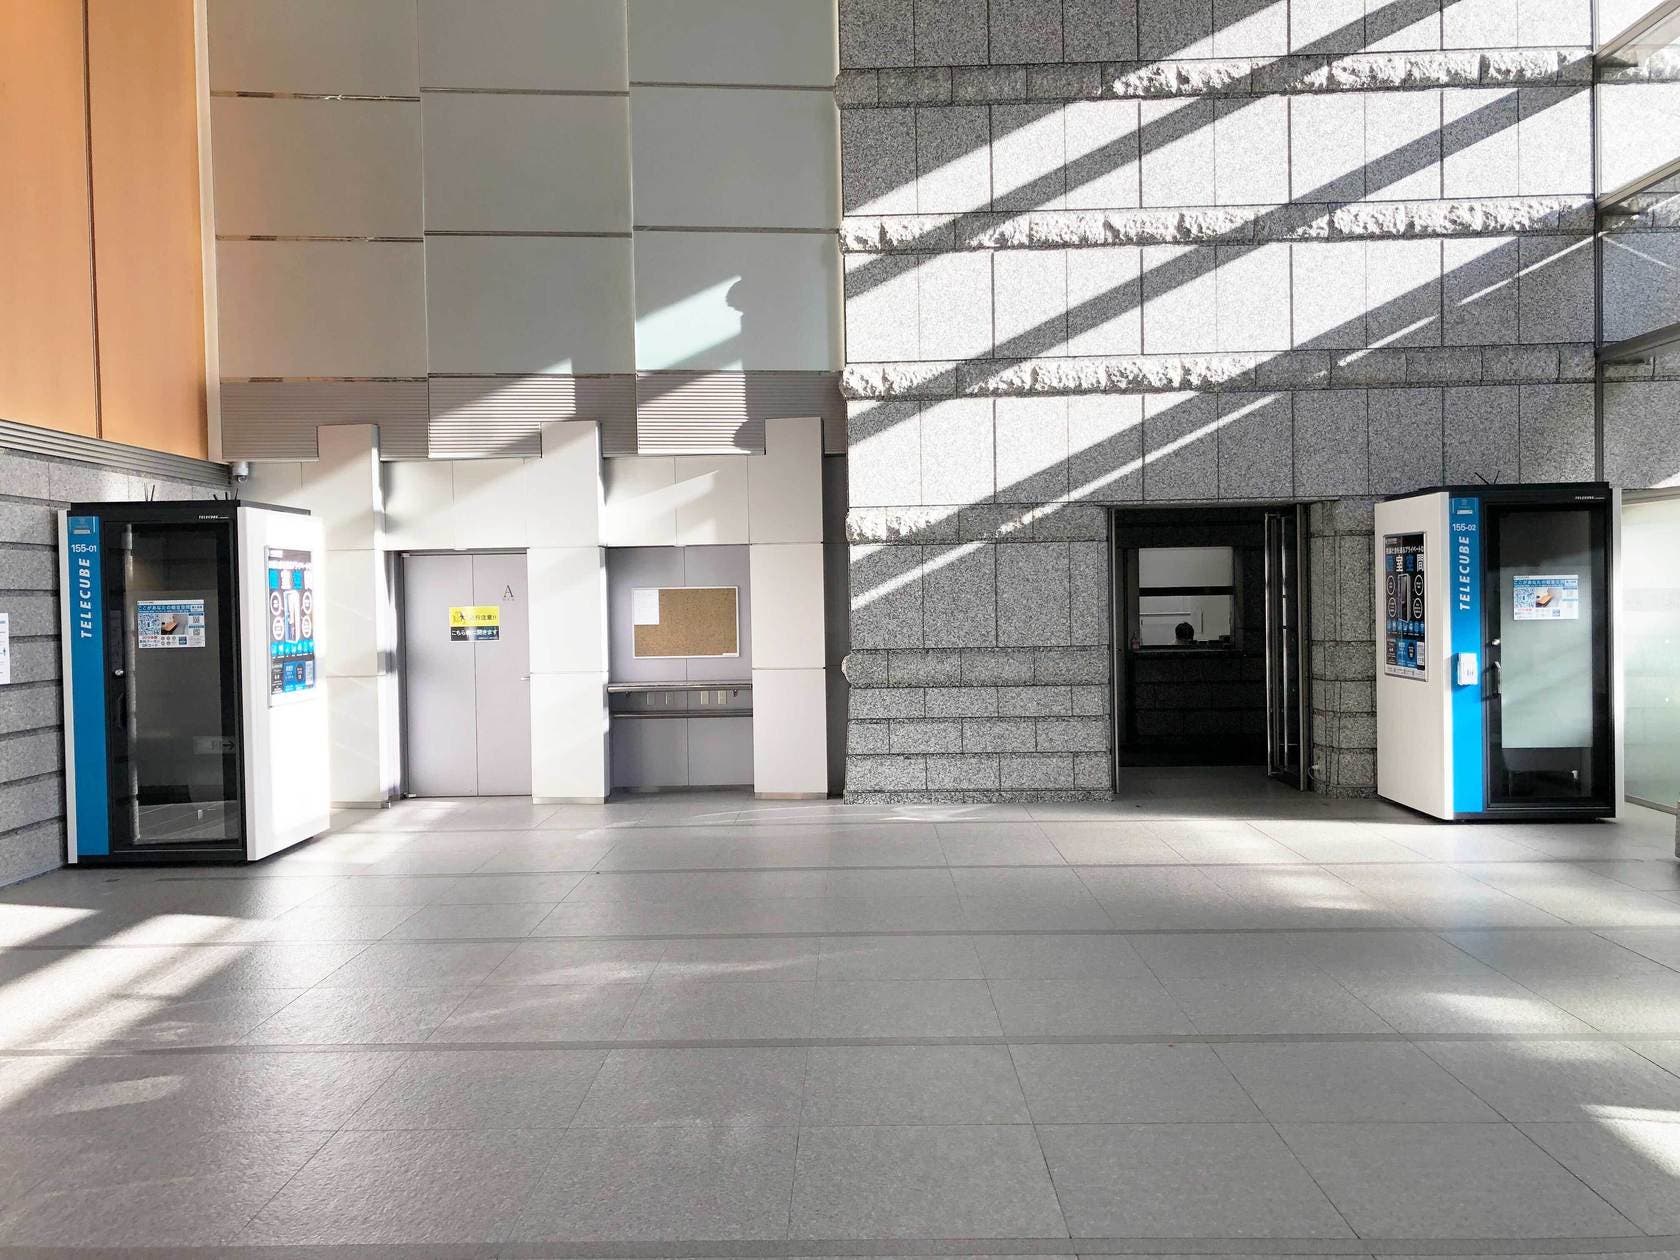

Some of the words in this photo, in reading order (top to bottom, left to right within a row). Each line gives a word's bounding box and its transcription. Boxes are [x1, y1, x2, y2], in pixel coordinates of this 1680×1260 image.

[1452, 523, 1477, 531] 155-02
[70, 543, 97, 553] 155-01
[1459, 535, 1471, 611] TELECUBE
[78, 557, 93, 638] TELECUBE
[503, 585, 514, 598] A
